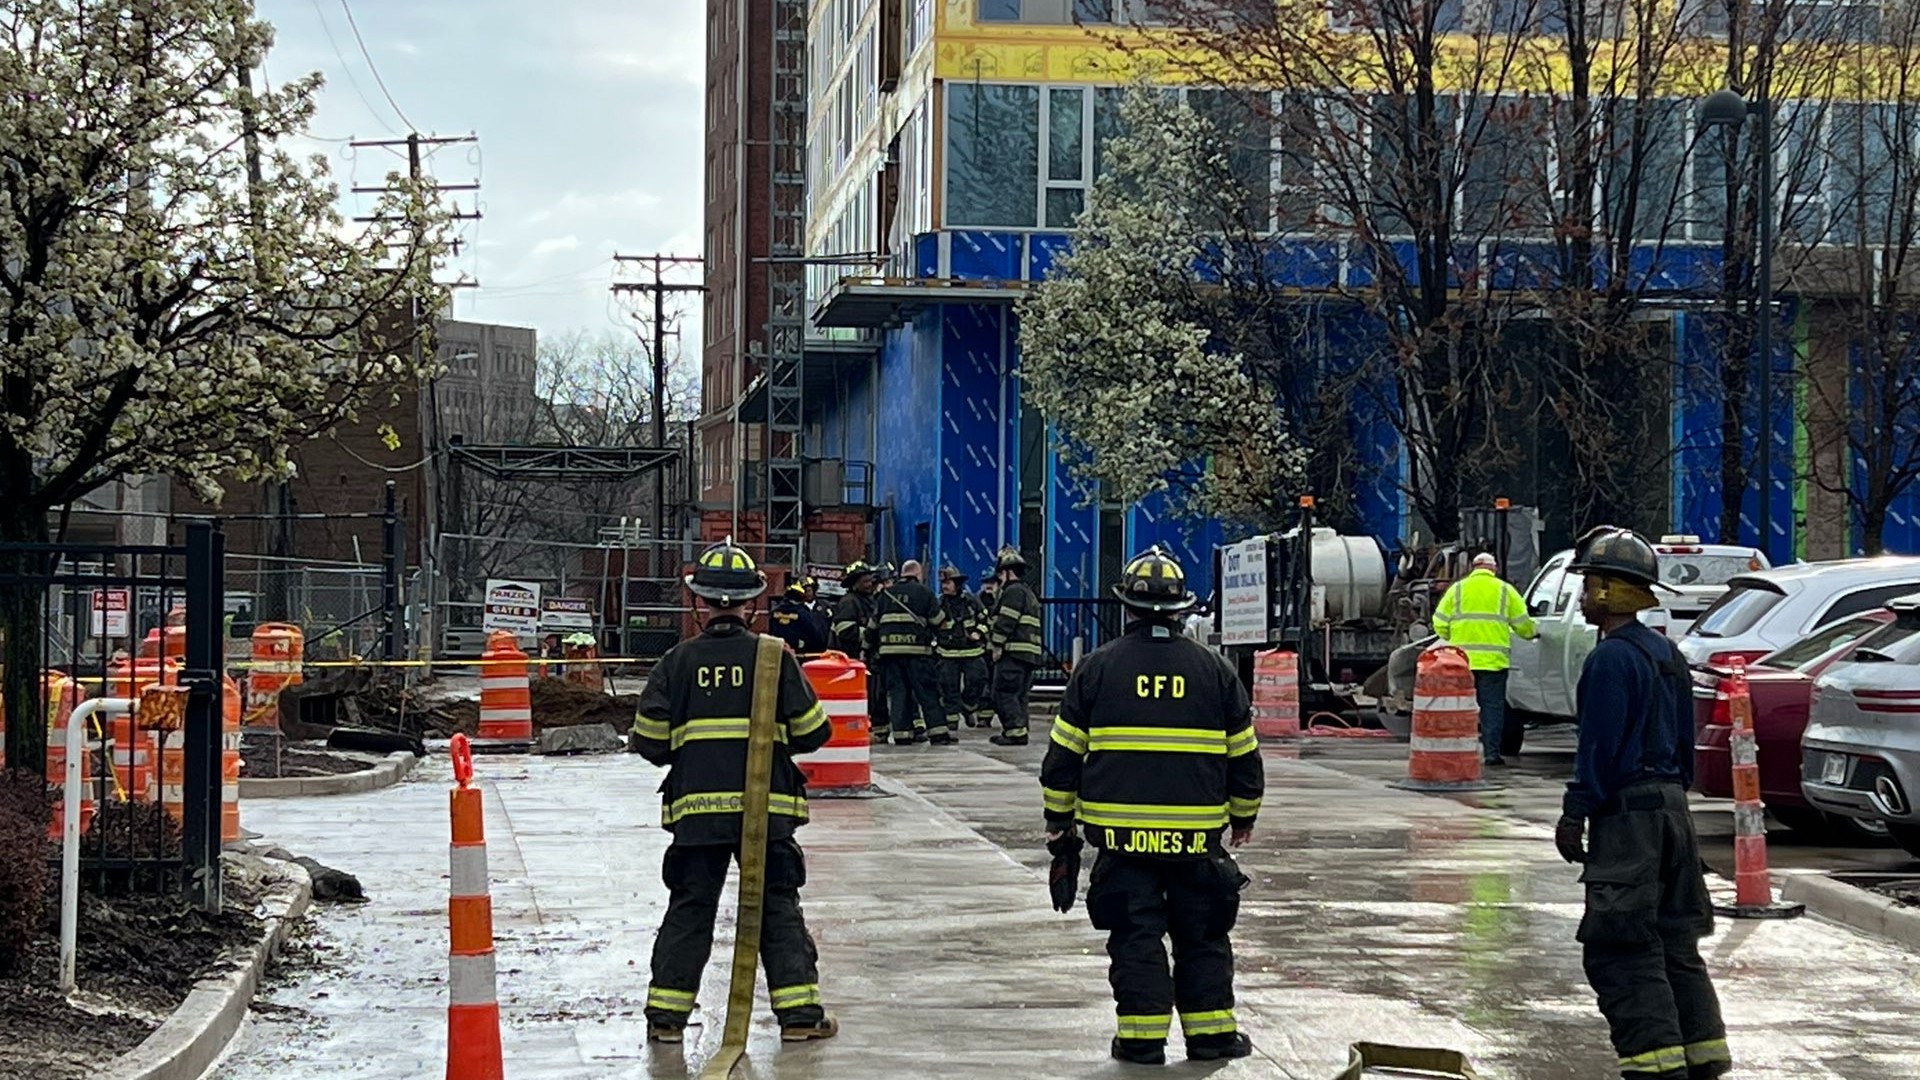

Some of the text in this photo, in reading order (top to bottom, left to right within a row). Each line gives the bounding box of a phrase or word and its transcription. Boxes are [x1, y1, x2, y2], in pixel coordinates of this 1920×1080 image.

[492, 605, 520, 615] GATE
[549, 602, 586, 610] DANGER
[698, 665, 744, 688] CFD
[1136, 675, 1186, 699] CFD
[685, 795, 745, 812] WAHLG
[1124, 831, 1184, 854] JONES
